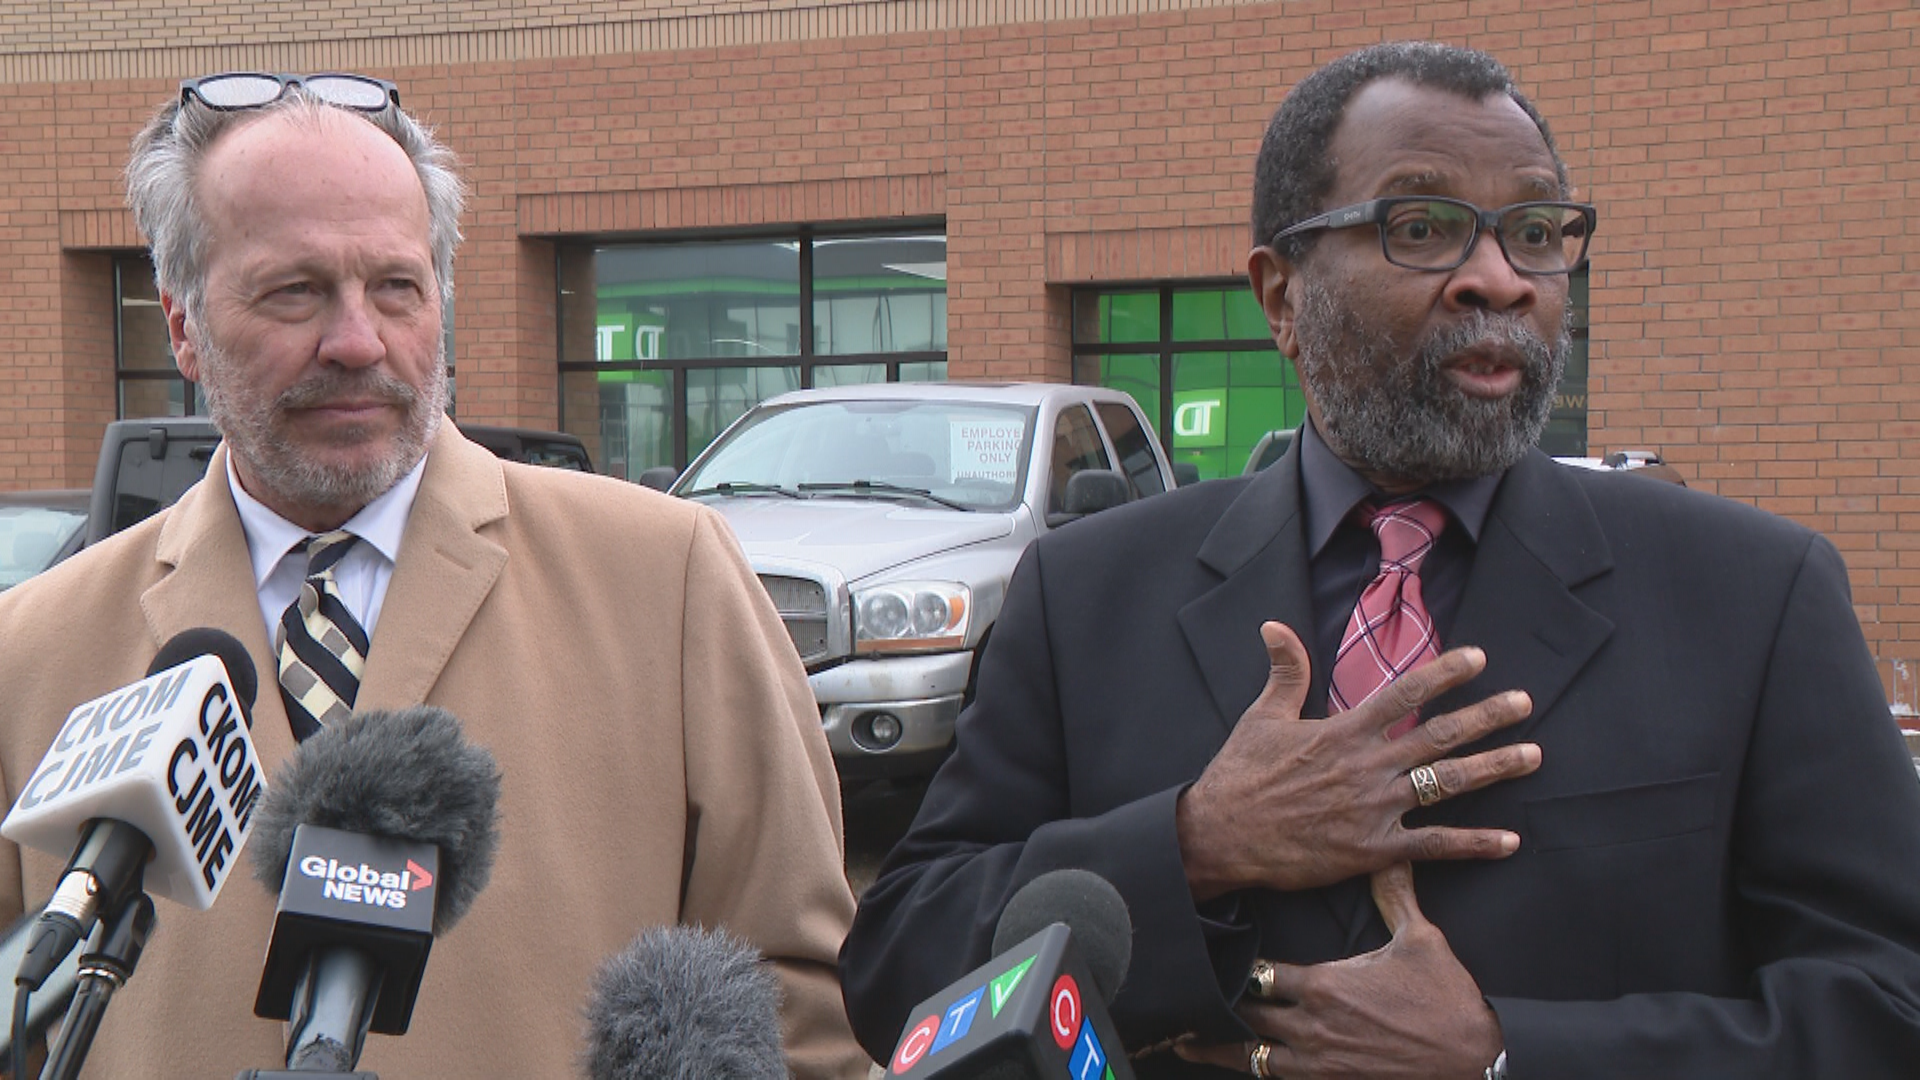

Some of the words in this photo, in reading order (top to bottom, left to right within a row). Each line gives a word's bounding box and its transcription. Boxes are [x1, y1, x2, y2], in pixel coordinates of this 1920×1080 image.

[961, 427, 1022, 439] EMPLOYE
[979, 453, 1011, 464] ONLY
[54, 667, 193, 752] CKOM
[19, 721, 163, 810] CJME
[199, 682, 263, 833] CKOM
[167, 736, 234, 892] CJME
[300, 855, 411, 891] Global
[323, 880, 407, 909] NEWS
